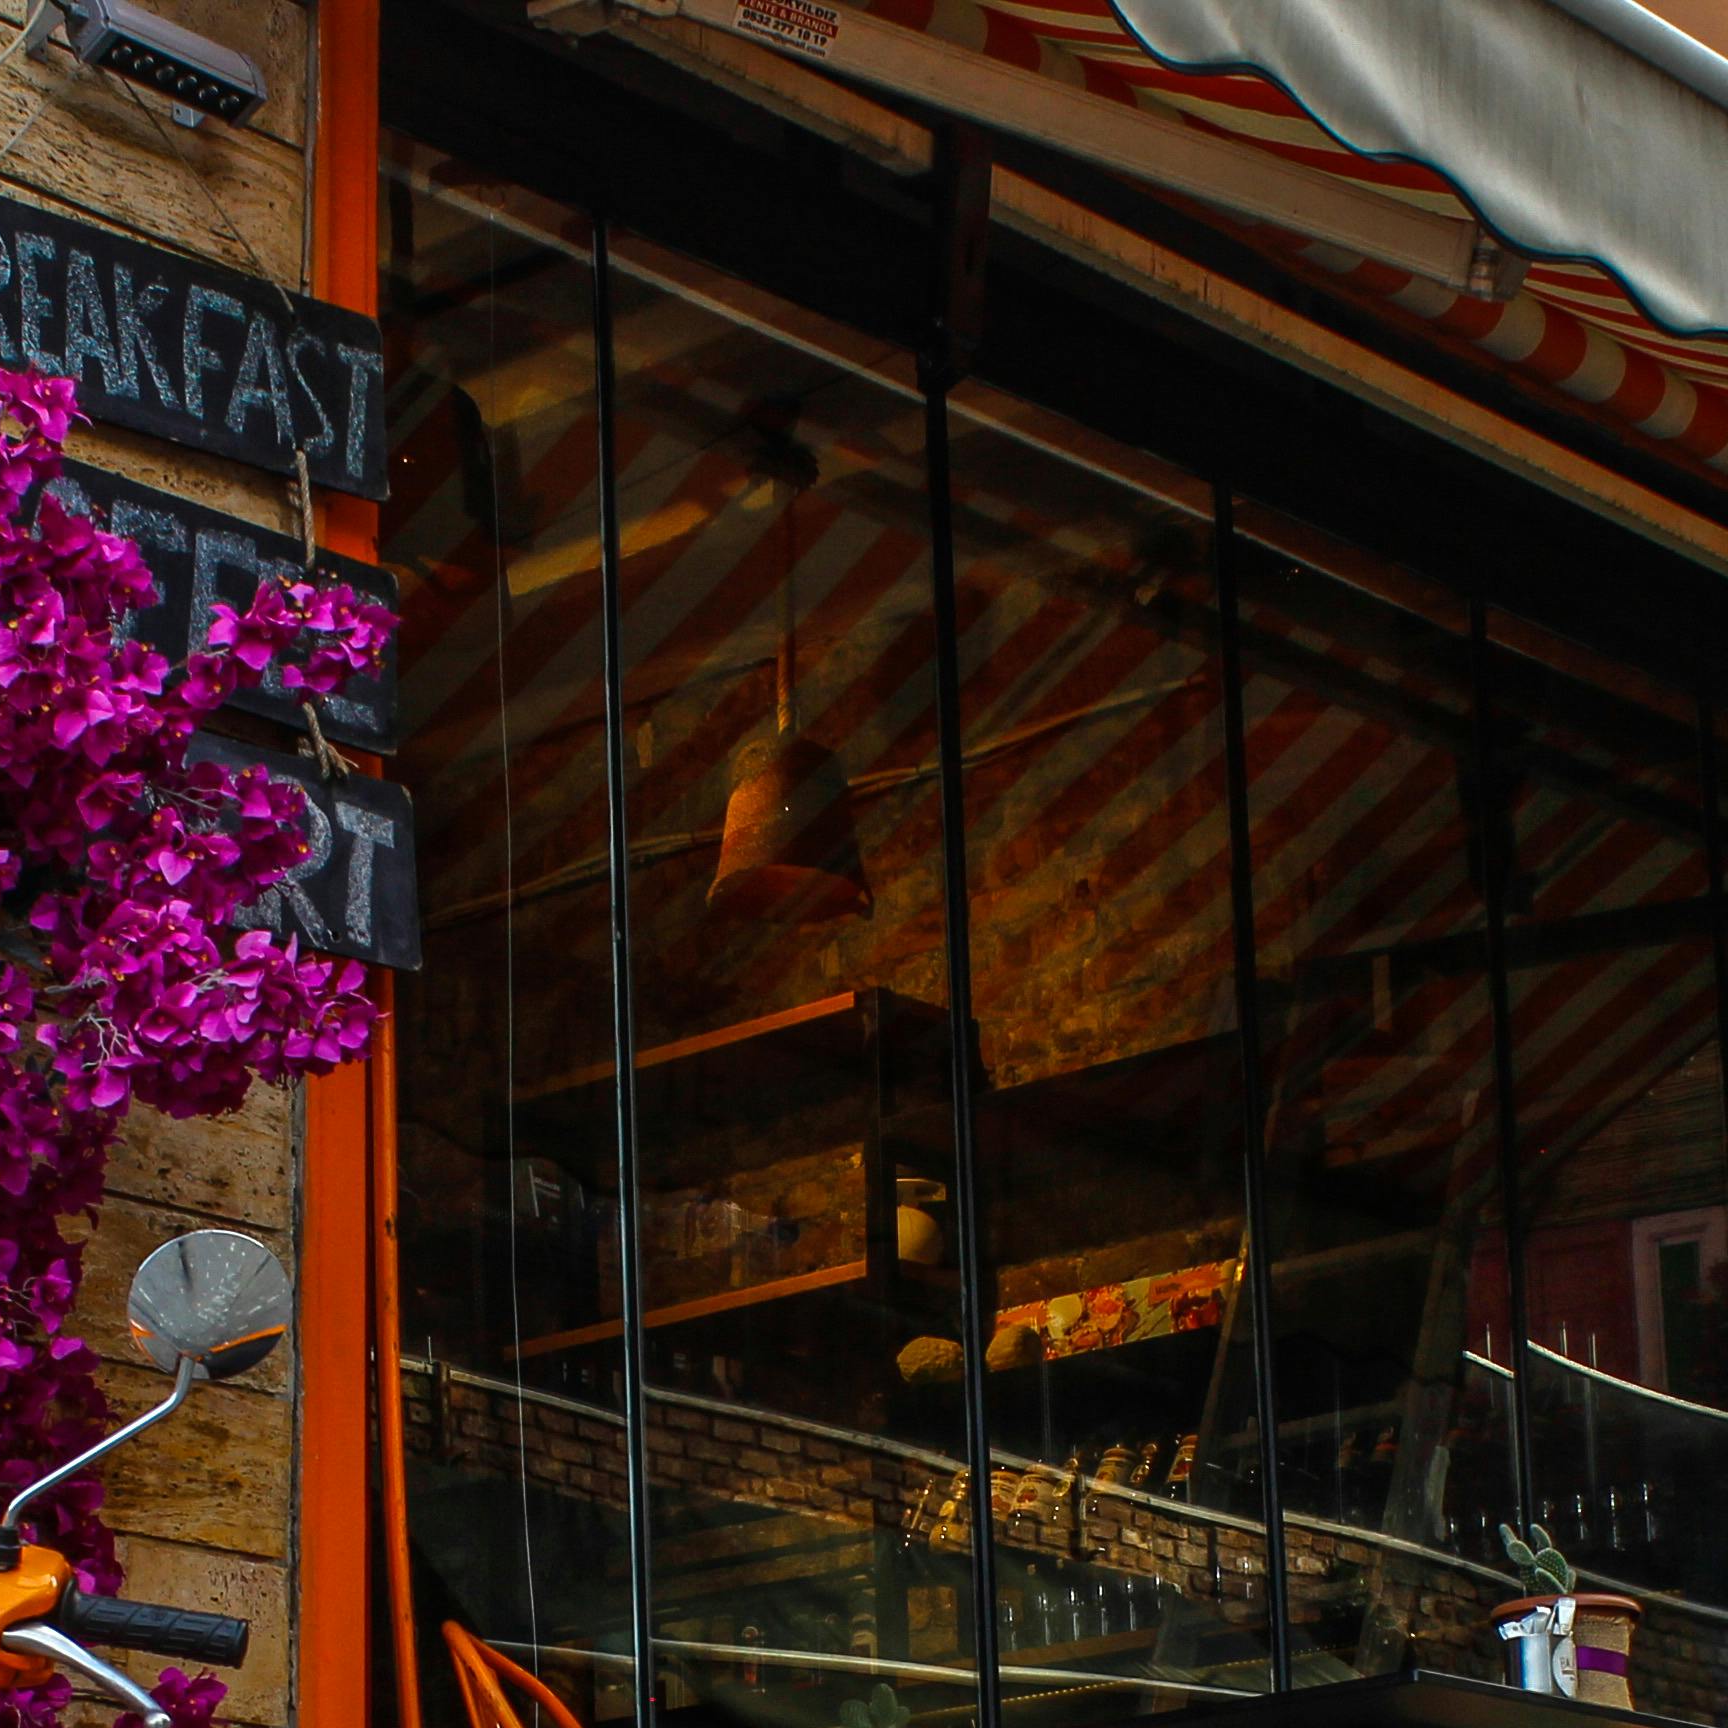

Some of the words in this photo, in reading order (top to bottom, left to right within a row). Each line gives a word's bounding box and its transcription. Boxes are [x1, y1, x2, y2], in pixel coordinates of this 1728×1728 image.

[742, 8, 770, 26] 0532
[772, 20, 794, 34] 277
[789, 12, 833, 35] BRANDA
